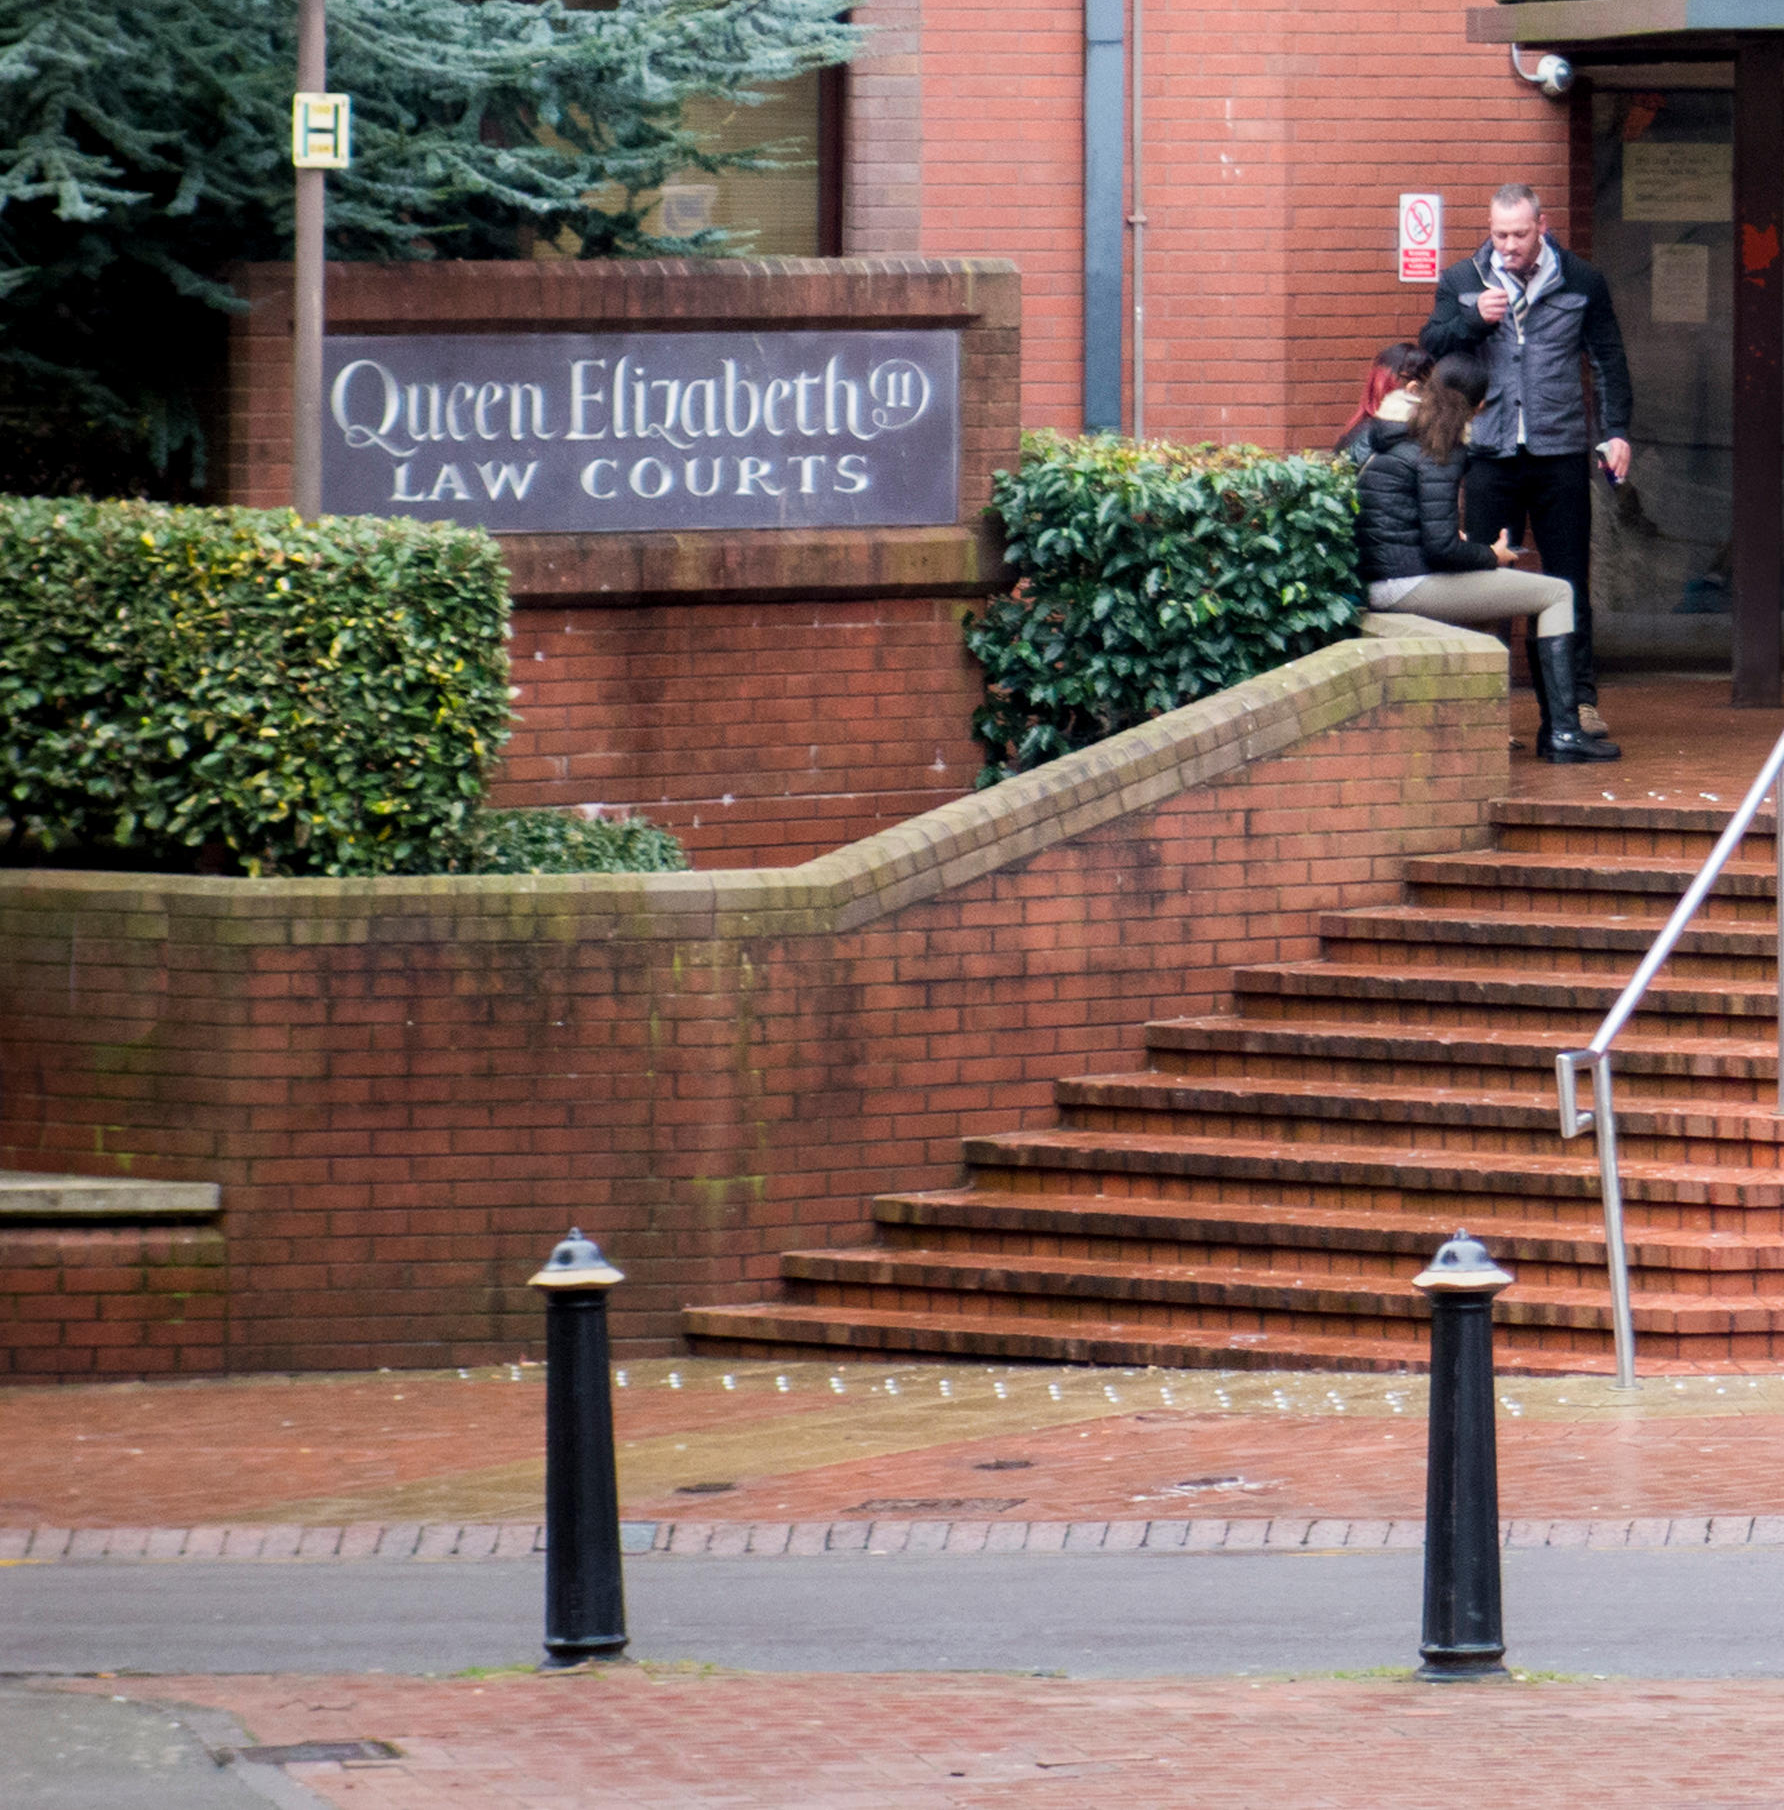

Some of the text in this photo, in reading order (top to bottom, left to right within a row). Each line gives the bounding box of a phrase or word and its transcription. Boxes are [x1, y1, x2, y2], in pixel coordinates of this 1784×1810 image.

[303, 102, 340, 158] H
[330, 359, 558, 457] Queen
[564, 354, 878, 449] Elizabeth
[390, 453, 870, 501] LAW COURTS
